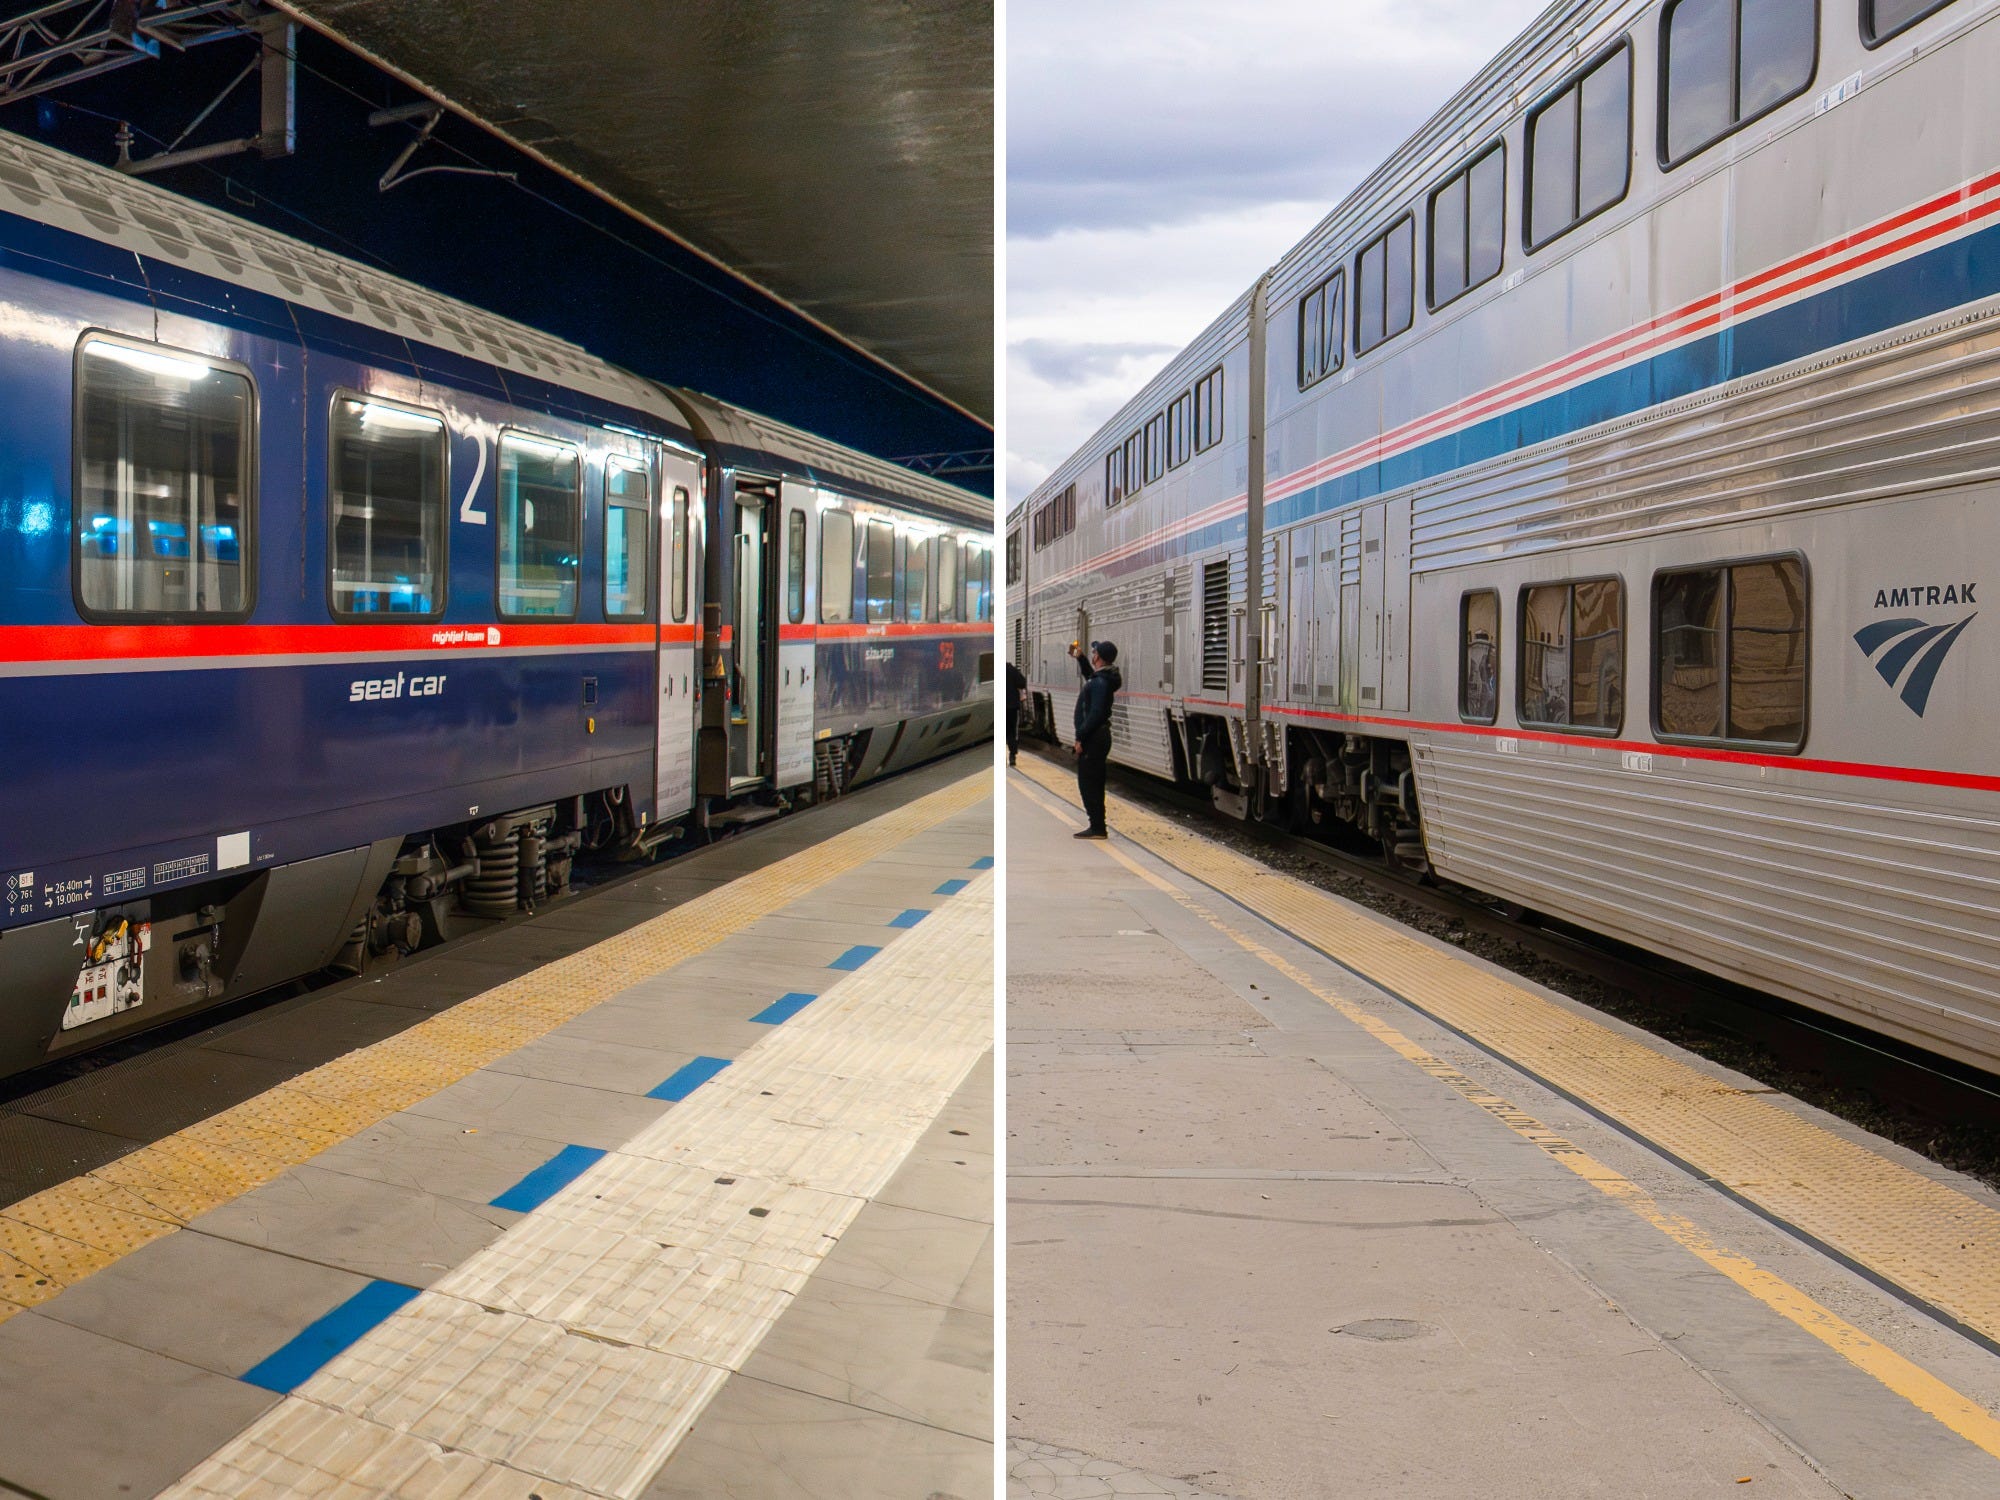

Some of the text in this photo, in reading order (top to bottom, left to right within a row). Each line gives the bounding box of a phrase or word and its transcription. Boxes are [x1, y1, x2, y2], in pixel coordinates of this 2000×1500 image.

[460, 424, 487, 525] 2
[1873, 582, 1977, 609] AMTRAK
[432, 630, 464, 645] nightjet
[350, 671, 447, 702] seat car
[55, 880, 83, 894] 26.40m
[56, 892, 83, 906] 19.00m
[1478, 1101, 1548, 1130] YELLOW
[1528, 1135, 1585, 1155] LINE
